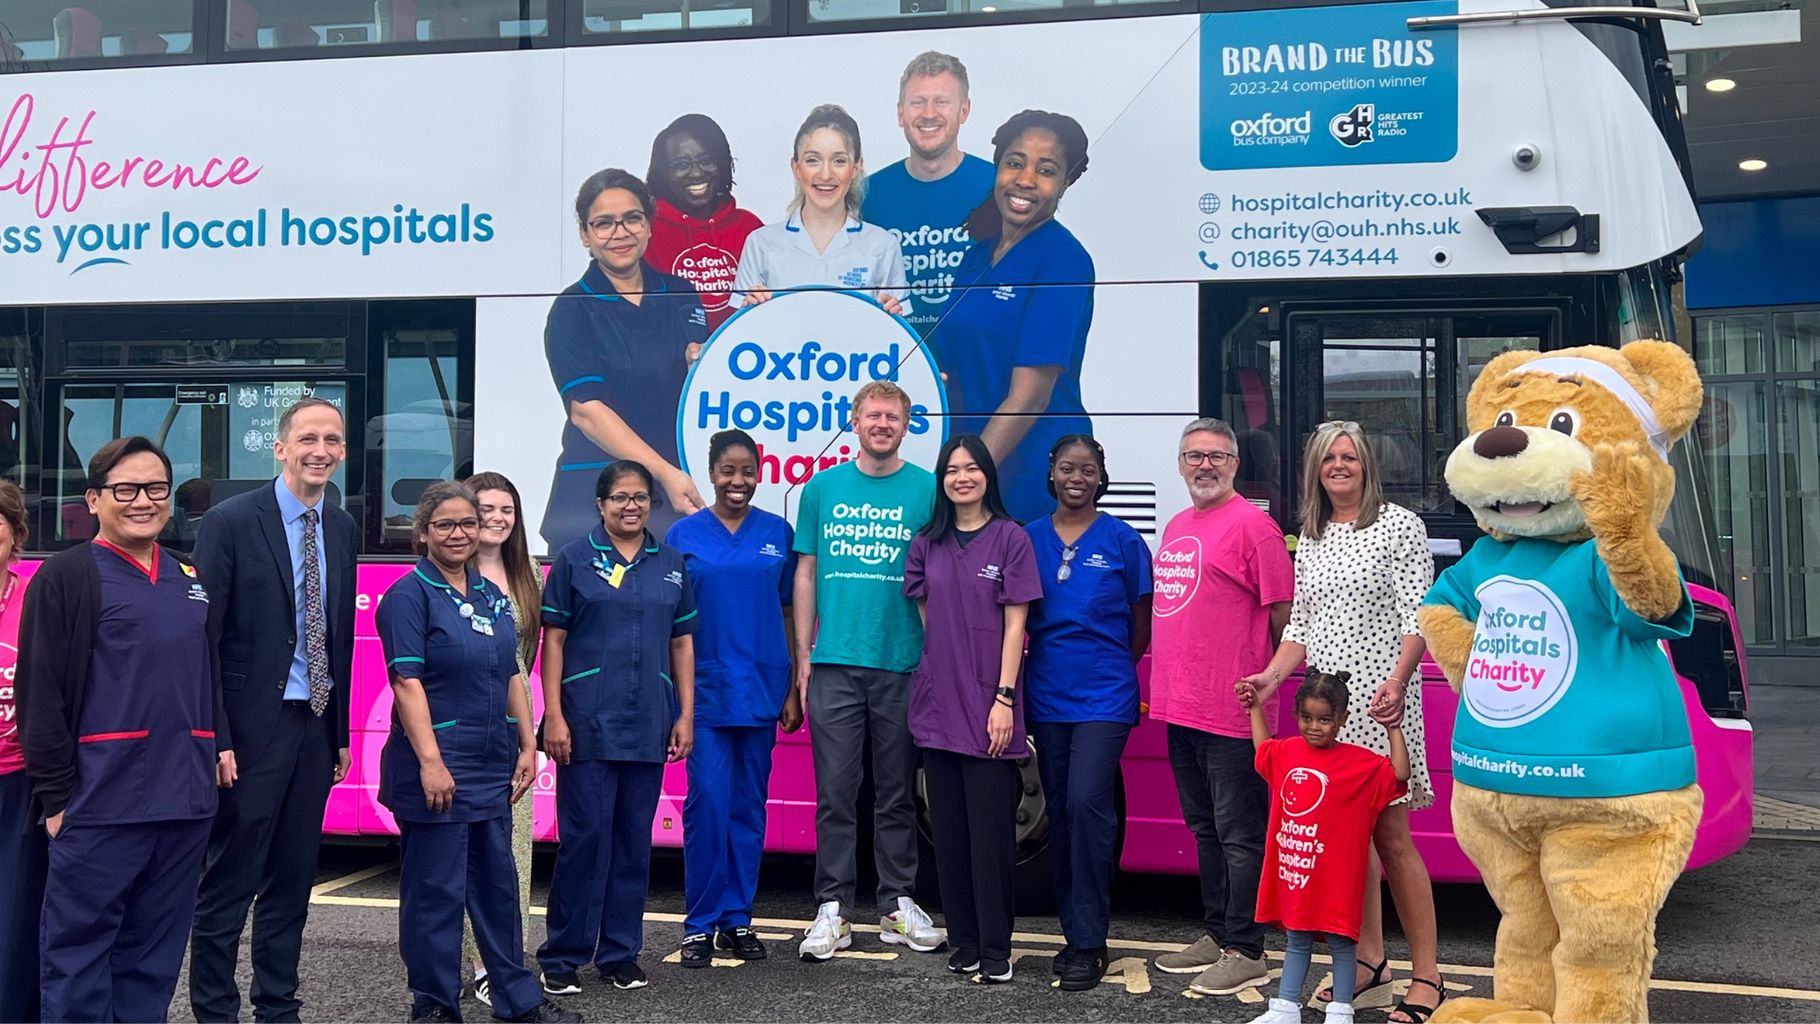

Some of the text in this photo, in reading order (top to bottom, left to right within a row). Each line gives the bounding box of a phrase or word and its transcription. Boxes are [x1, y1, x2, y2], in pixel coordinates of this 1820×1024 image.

[1222, 38, 1435, 76] BRAND THE BUS
[1229, 76, 1428, 95] 2023-24 competition winner
[1230, 111, 1311, 137] oxford
[1377, 112, 1424, 121] GREATEST
[1377, 120, 1399, 129] HITS
[1233, 135, 1310, 146] bus company
[1377, 128, 1407, 136] RADIO
[1231, 187, 1473, 216] hospitalcharity.co.uk
[52, 222, 151, 263] your
[161, 208, 266, 249] local
[281, 203, 494, 256] hospitals
[1231, 217, 1462, 243] charity@ouh.nhs.uk
[1231, 248, 1399, 268] 01865 743444
[728, 341, 900, 382] Oxford
[264, 385, 316, 397] Funded by
[264, 397, 342, 408] UK Goent
[698, 391, 930, 442] Hospits
[832, 503, 903, 521] Oxford
[823, 522, 912, 541] Hospitals
[829, 540, 901, 563] Charity
[1159, 550, 1196, 562] Oxford
[824, 571, 905, 582] .hospitalcharity.co.uk
[1153, 564, 1196, 580] Hospitals
[1154, 580, 1188, 598] Charity
[1485, 607, 1547, 631] xford
[1470, 658, 1546, 690] Charity
